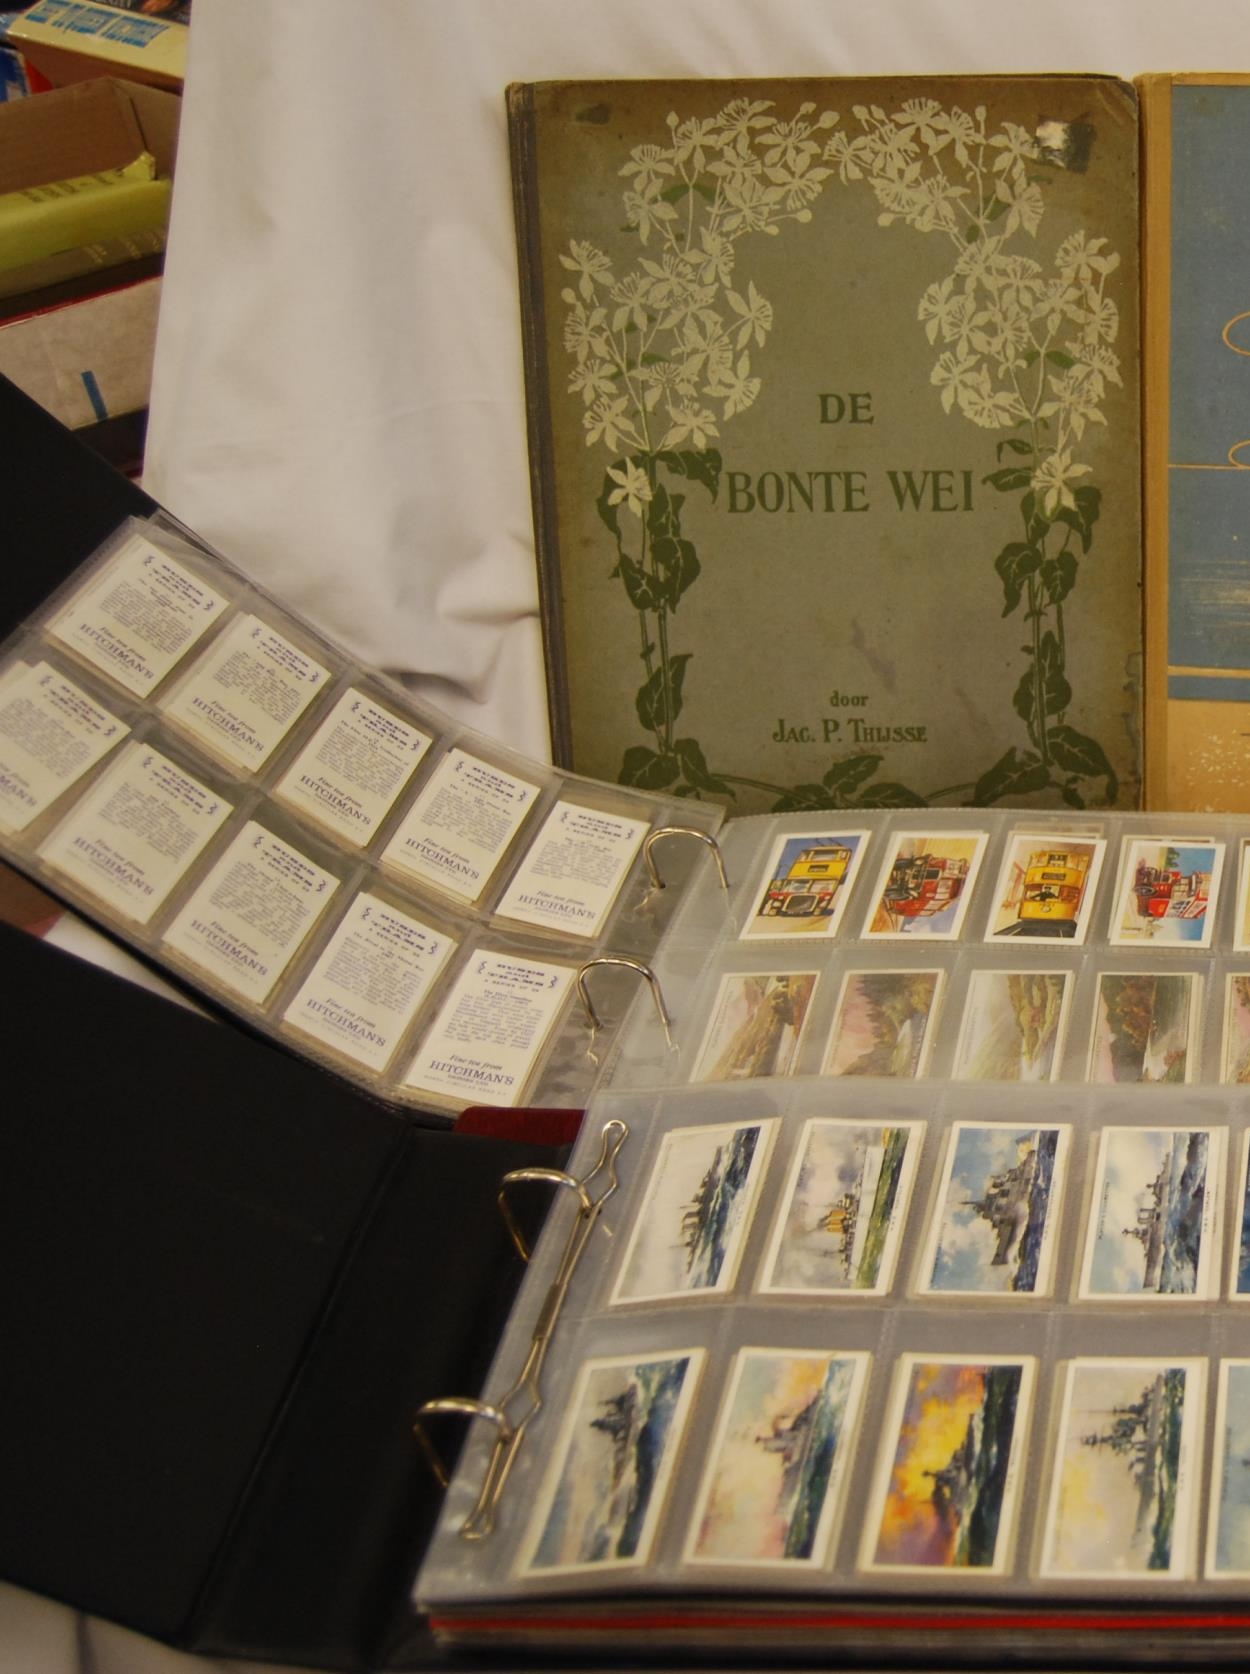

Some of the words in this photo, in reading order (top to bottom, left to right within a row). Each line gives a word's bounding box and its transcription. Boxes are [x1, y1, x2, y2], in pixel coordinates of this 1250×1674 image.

[817, 392, 875, 426] DE
[726, 470, 870, 513] BONTE
[886, 470, 975, 512] WEI
[829, 690, 869, 708] door
[822, 718, 842, 743] P.
[299, 773, 372, 826] HITCHMAN'S
[317, 775, 334, 789] Fine
[343, 794, 363, 810] from
[402, 837, 483, 880] HITCHMAN'S
[422, 836, 440, 848] Fine
[450, 851, 471, 864] from
[304, 997, 387, 1047] HITCHMAN'S
[324, 996, 344, 1010] Fine
[353, 1013, 377, 1030] from
[427, 1059, 516, 1086] HITCHMAN'S
[448, 1053, 468, 1063] Fine
[480, 1061, 503, 1072] from
